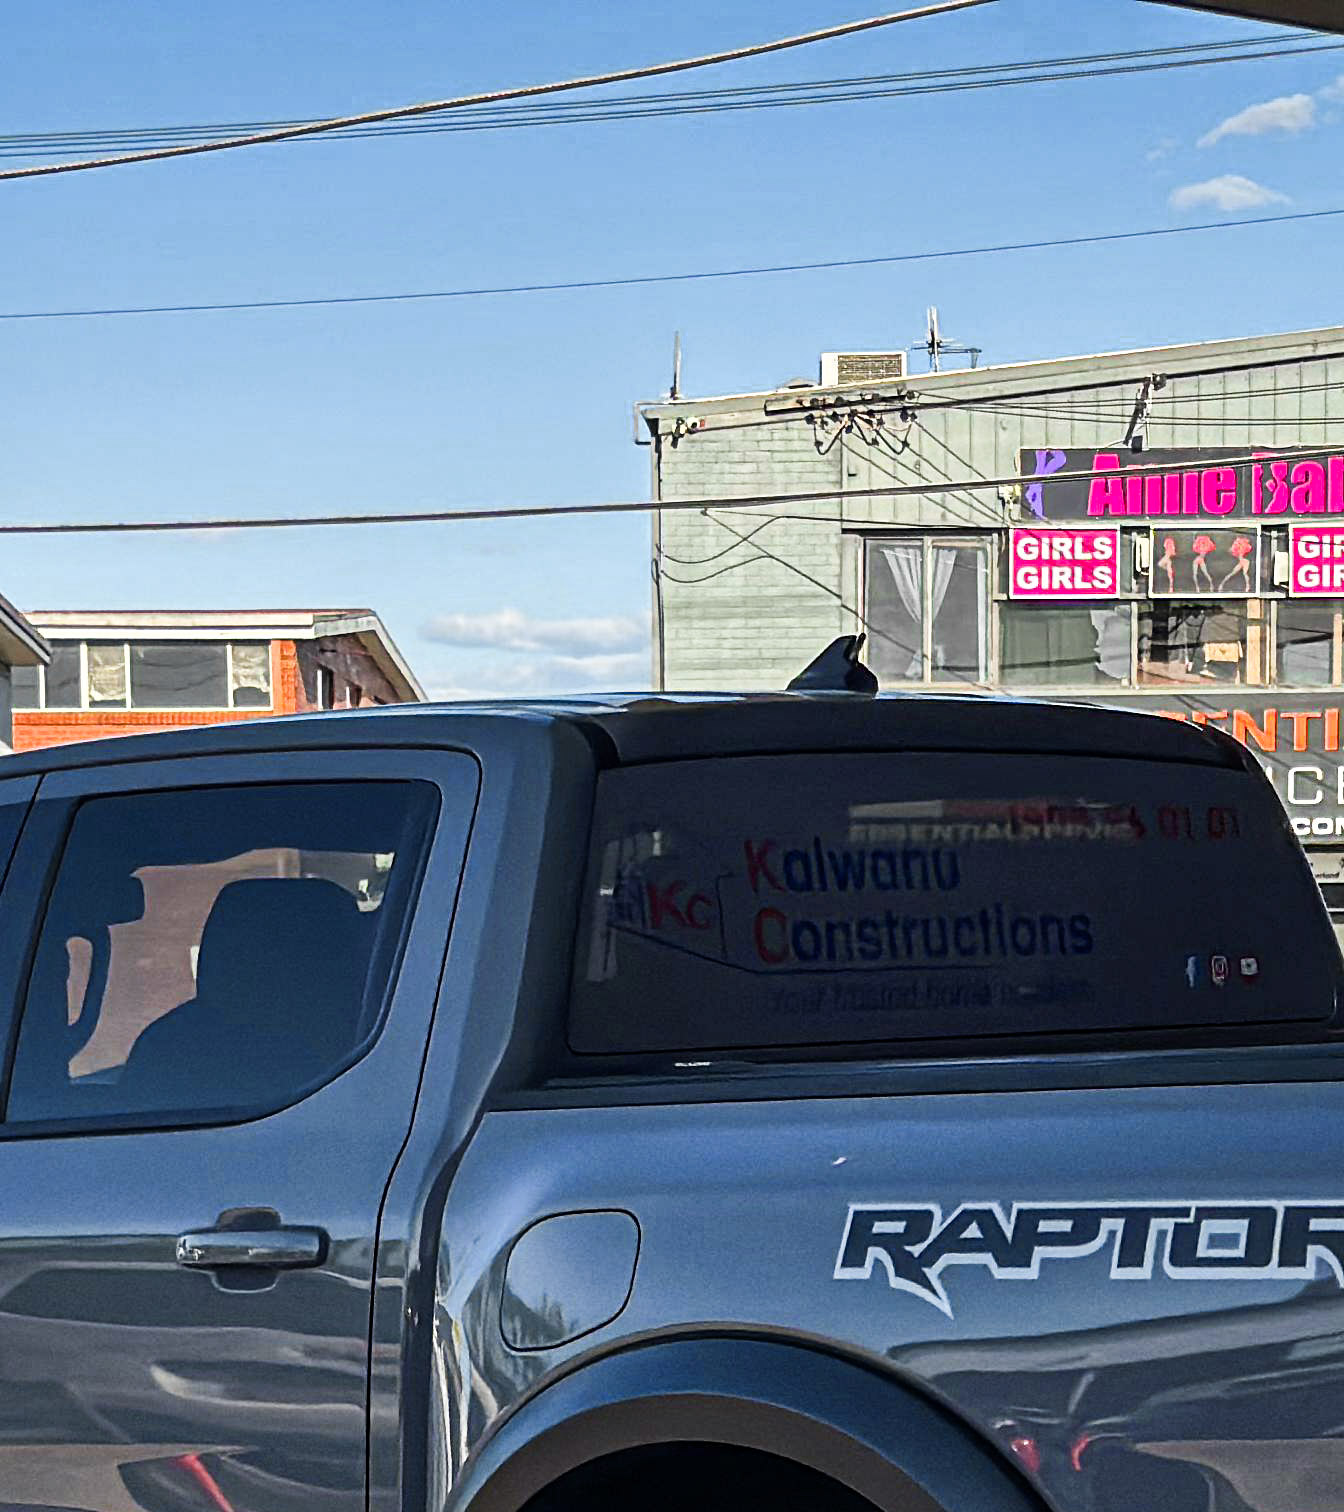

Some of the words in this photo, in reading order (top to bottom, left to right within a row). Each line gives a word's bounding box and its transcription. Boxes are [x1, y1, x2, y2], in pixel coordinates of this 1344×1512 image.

[1086, 452, 1237, 516] Anne
[1016, 536, 1113, 561] GIRLS
[1016, 566, 1113, 590] GIRLS
[754, 902, 1095, 966] Constructions
